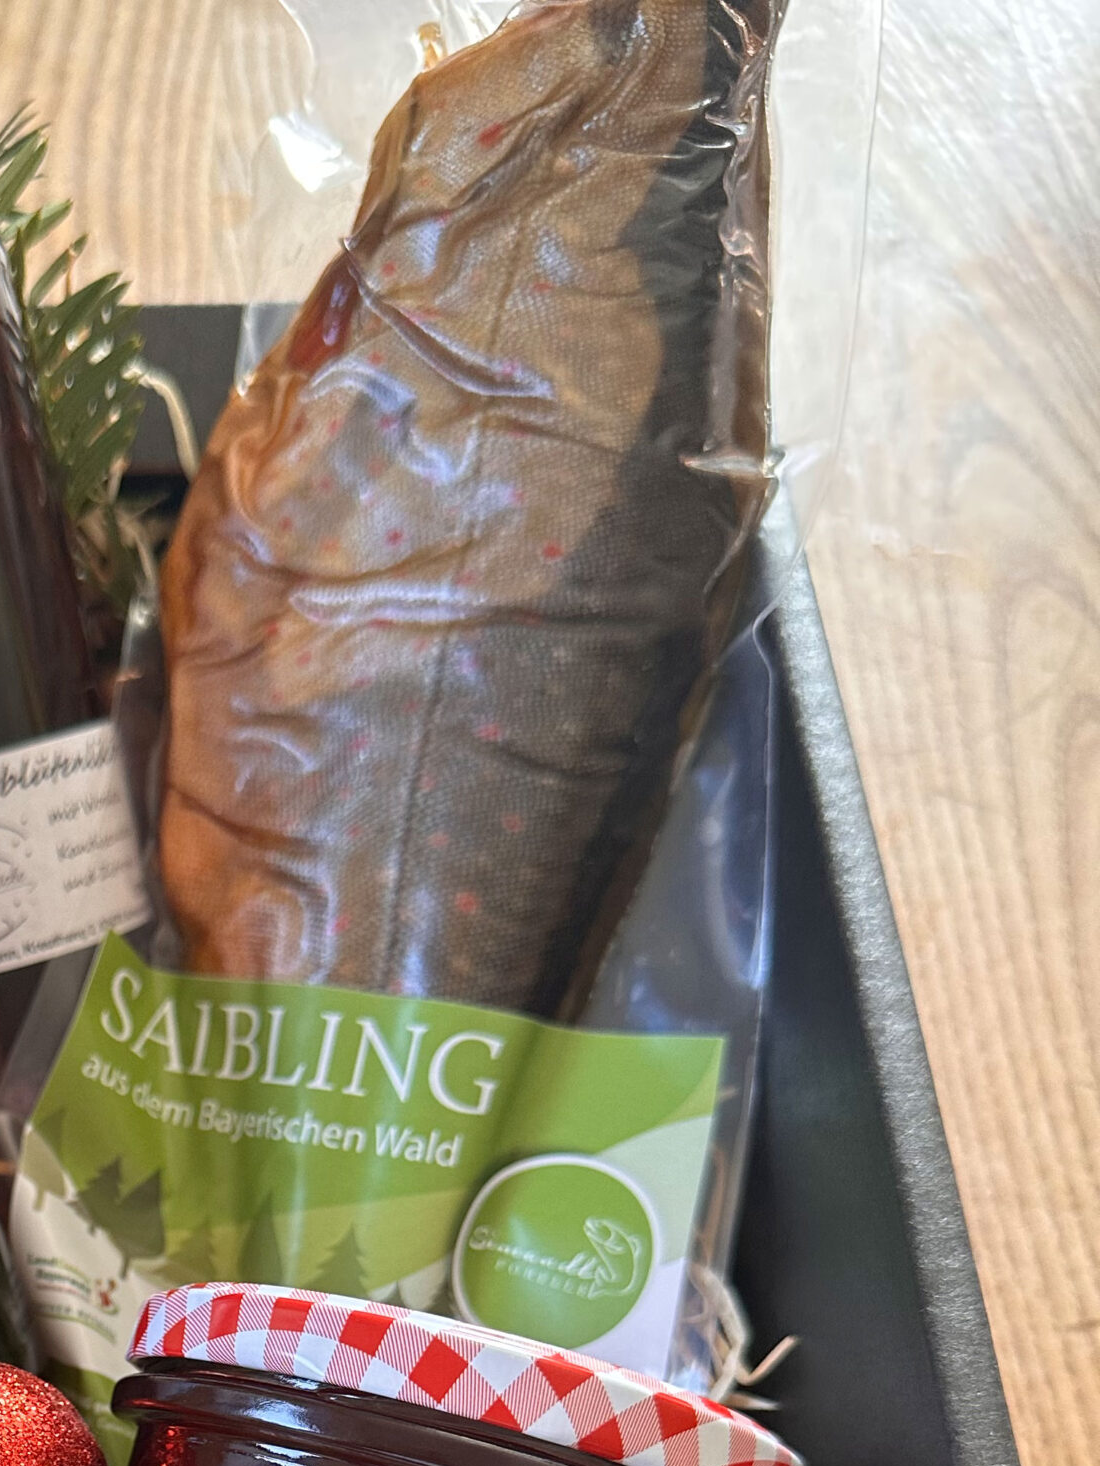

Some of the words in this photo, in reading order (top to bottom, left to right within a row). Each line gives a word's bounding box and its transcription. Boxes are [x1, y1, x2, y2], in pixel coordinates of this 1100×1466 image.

[101, 967, 504, 1116] SAIBLING
[81, 1051, 131, 1099] aus
[131, 1081, 195, 1129] dem
[198, 1099, 367, 1158] Bayerischen
[375, 1122, 464, 1170] Wald
